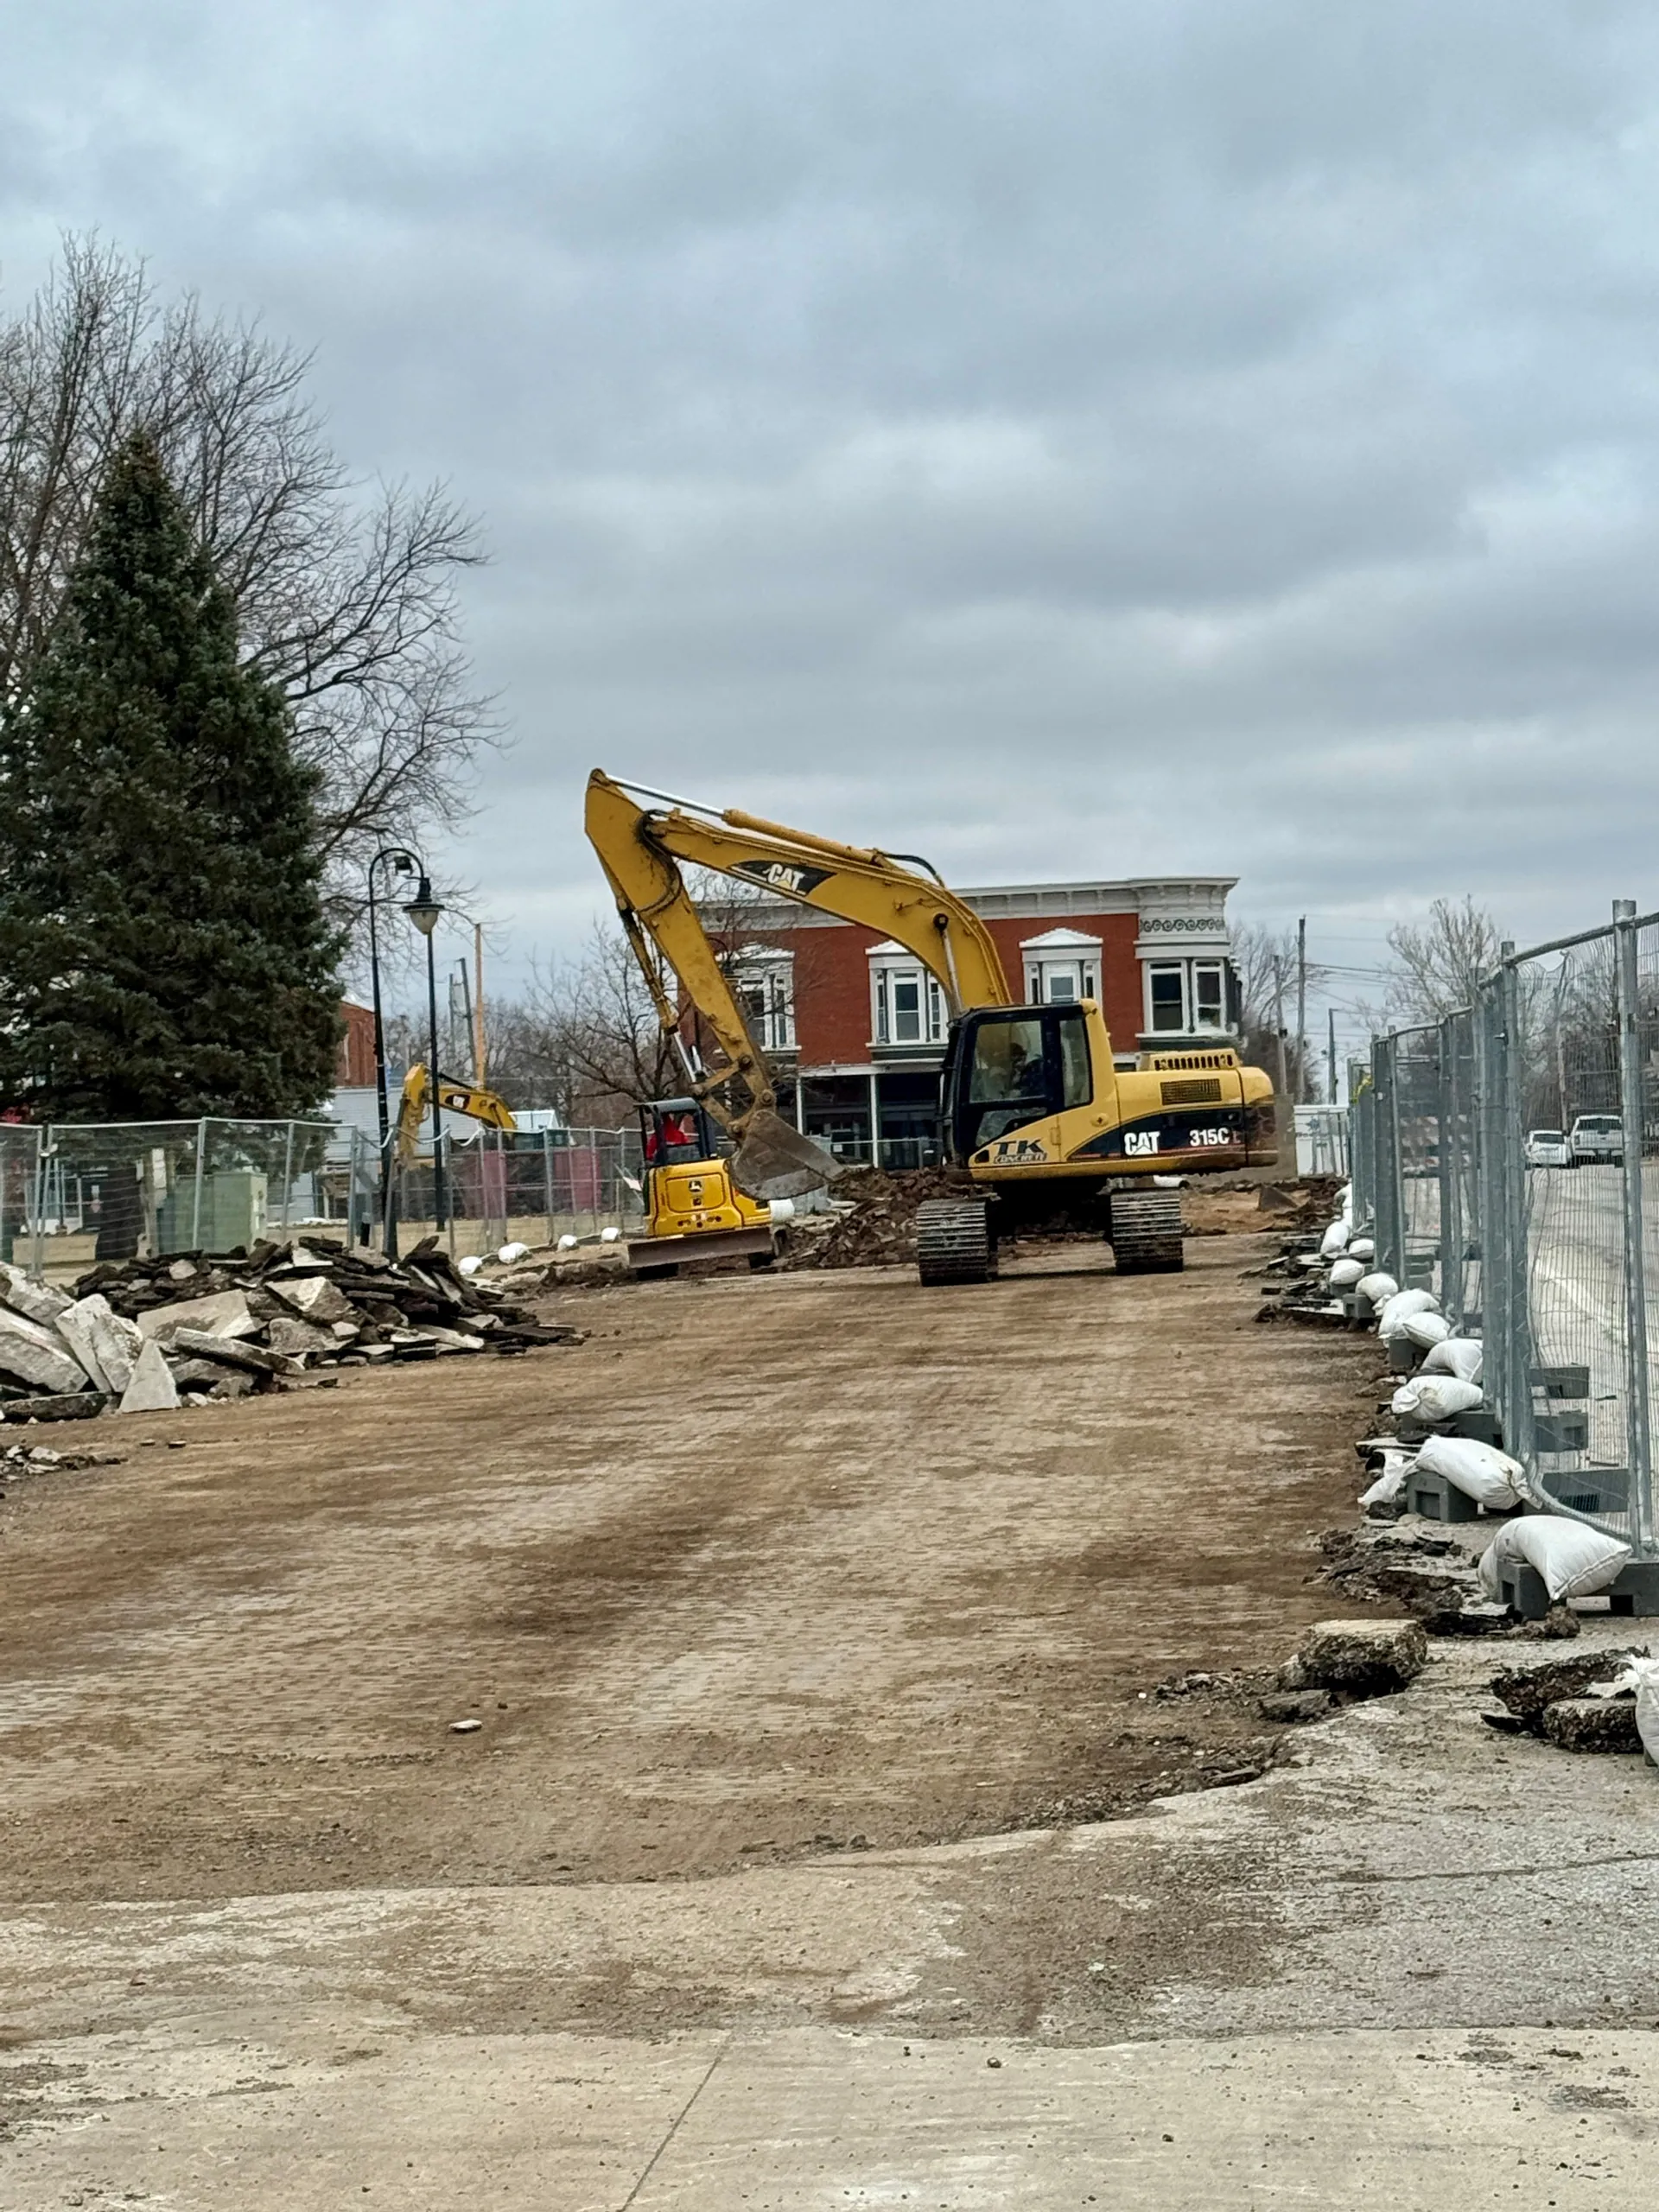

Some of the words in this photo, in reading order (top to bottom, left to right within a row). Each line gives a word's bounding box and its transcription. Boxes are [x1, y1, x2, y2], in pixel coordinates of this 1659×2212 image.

[767, 863, 805, 891] CAT
[993, 1139, 1044, 1154] TK
[1124, 1131, 1160, 1156] CAT
[1189, 1127, 1230, 1147] 315C
